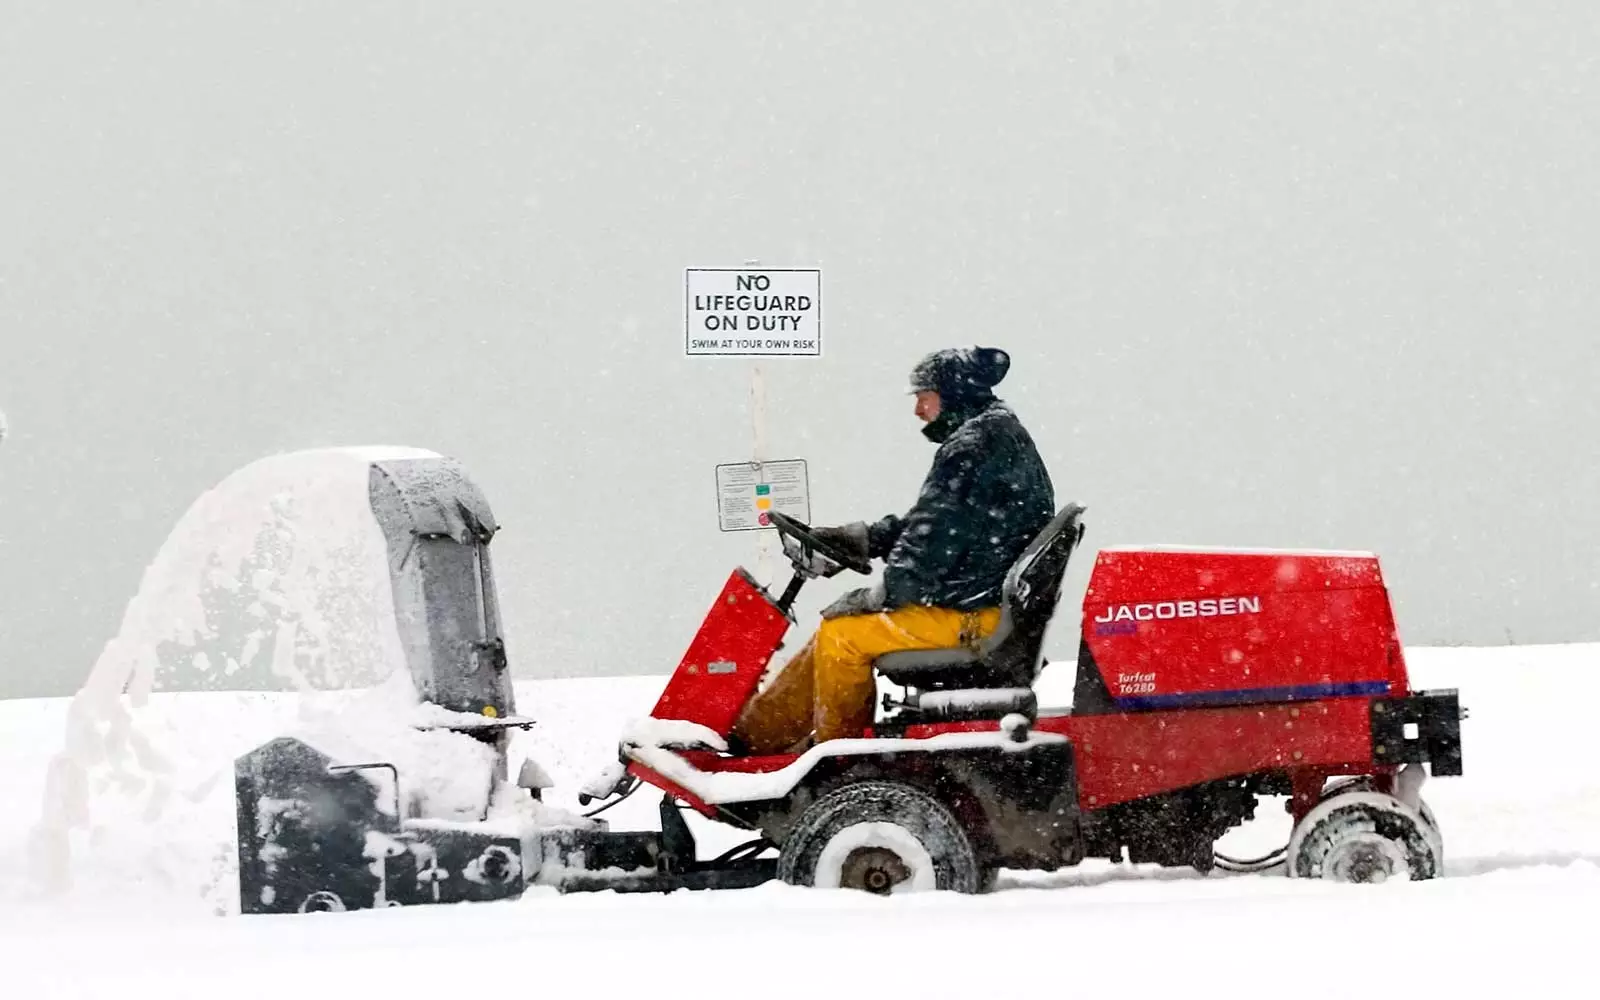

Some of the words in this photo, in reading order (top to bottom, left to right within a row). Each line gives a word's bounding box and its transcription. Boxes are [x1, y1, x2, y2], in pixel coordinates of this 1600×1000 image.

[736, 275, 771, 292] NO
[695, 295, 812, 311] LIFEGUARD
[704, 315, 738, 331] ON
[747, 315, 803, 331] DUTY
[691, 339, 719, 349] SWIM
[721, 339, 734, 349] AT
[736, 339, 762, 349] YOUR
[765, 339, 790, 349] OWN
[793, 339, 815, 349] RISK
[1094, 596, 1261, 623] JACOBSEN
[1117, 672, 1156, 683] Turfcat
[1119, 682, 1156, 694] T628D
